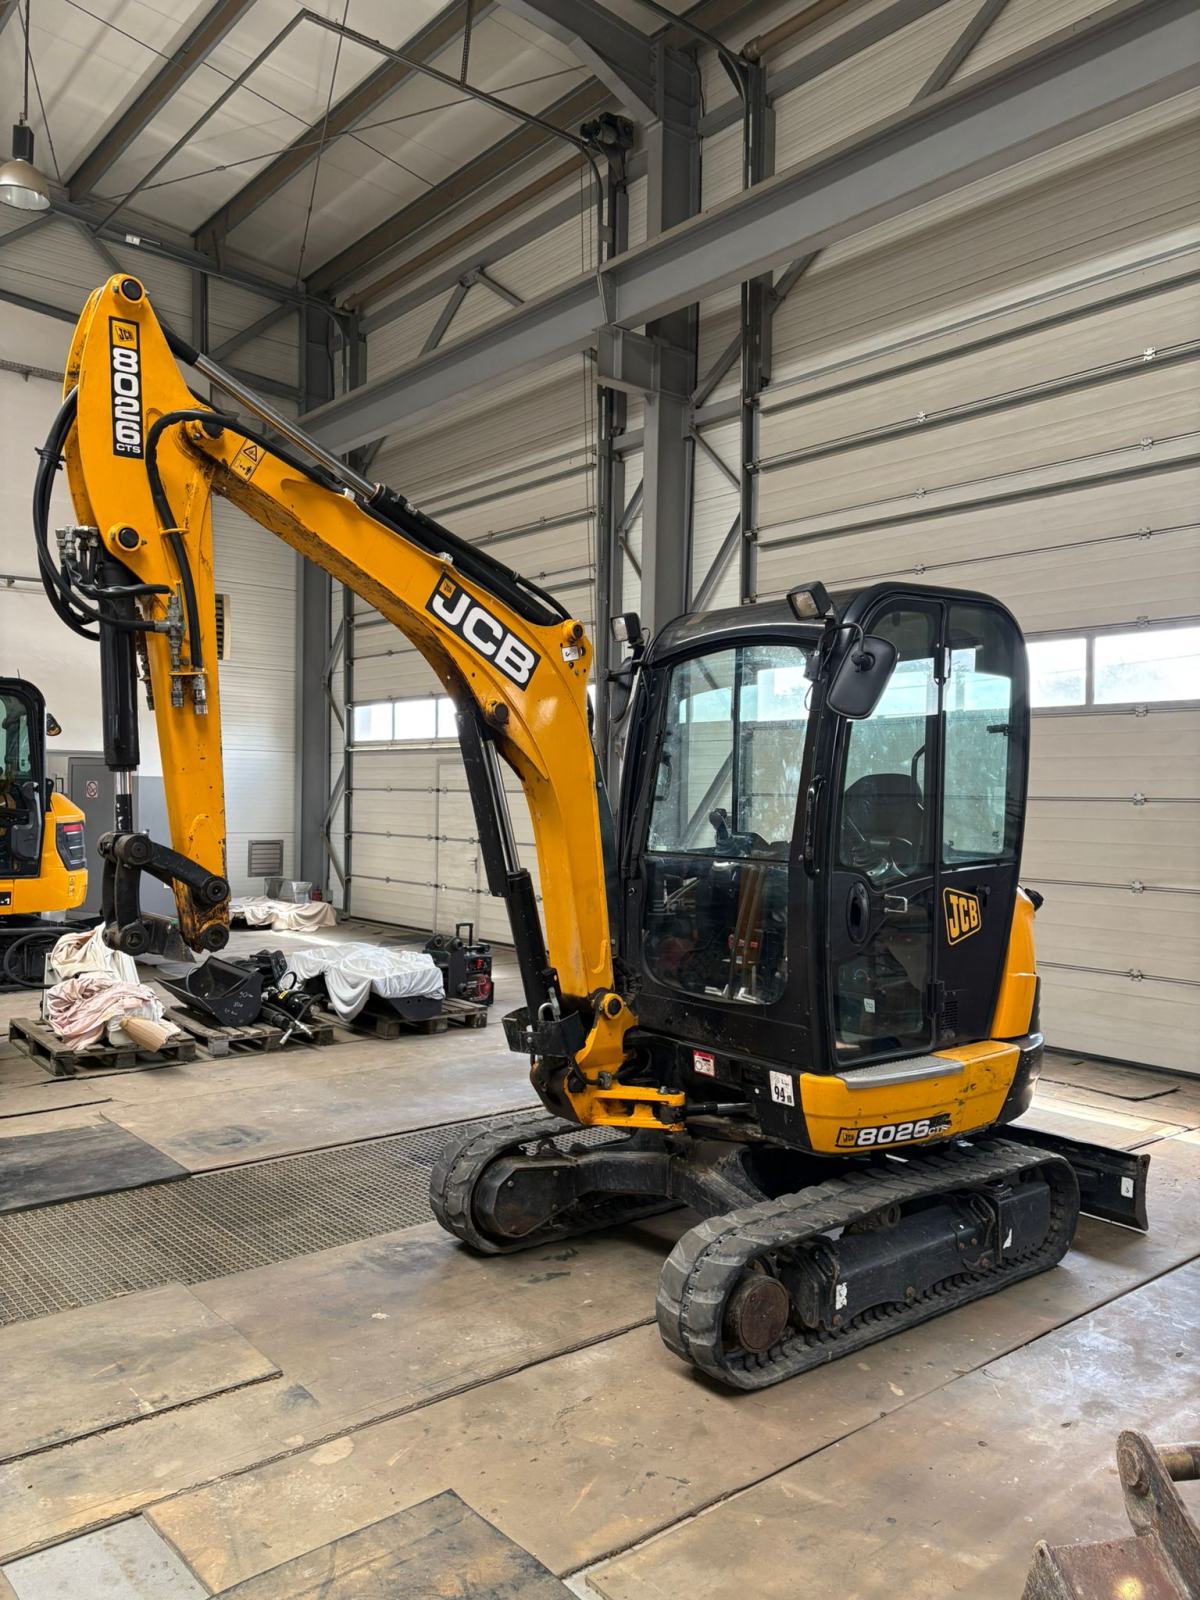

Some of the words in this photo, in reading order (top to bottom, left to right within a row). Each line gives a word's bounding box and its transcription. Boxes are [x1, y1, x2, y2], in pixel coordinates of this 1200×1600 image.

[113, 348, 141, 444] 8026
[116, 444, 141, 453] CTS
[432, 593, 535, 684] JCB
[949, 894, 978, 938] JCB
[857, 1120, 930, 1145] 8026
